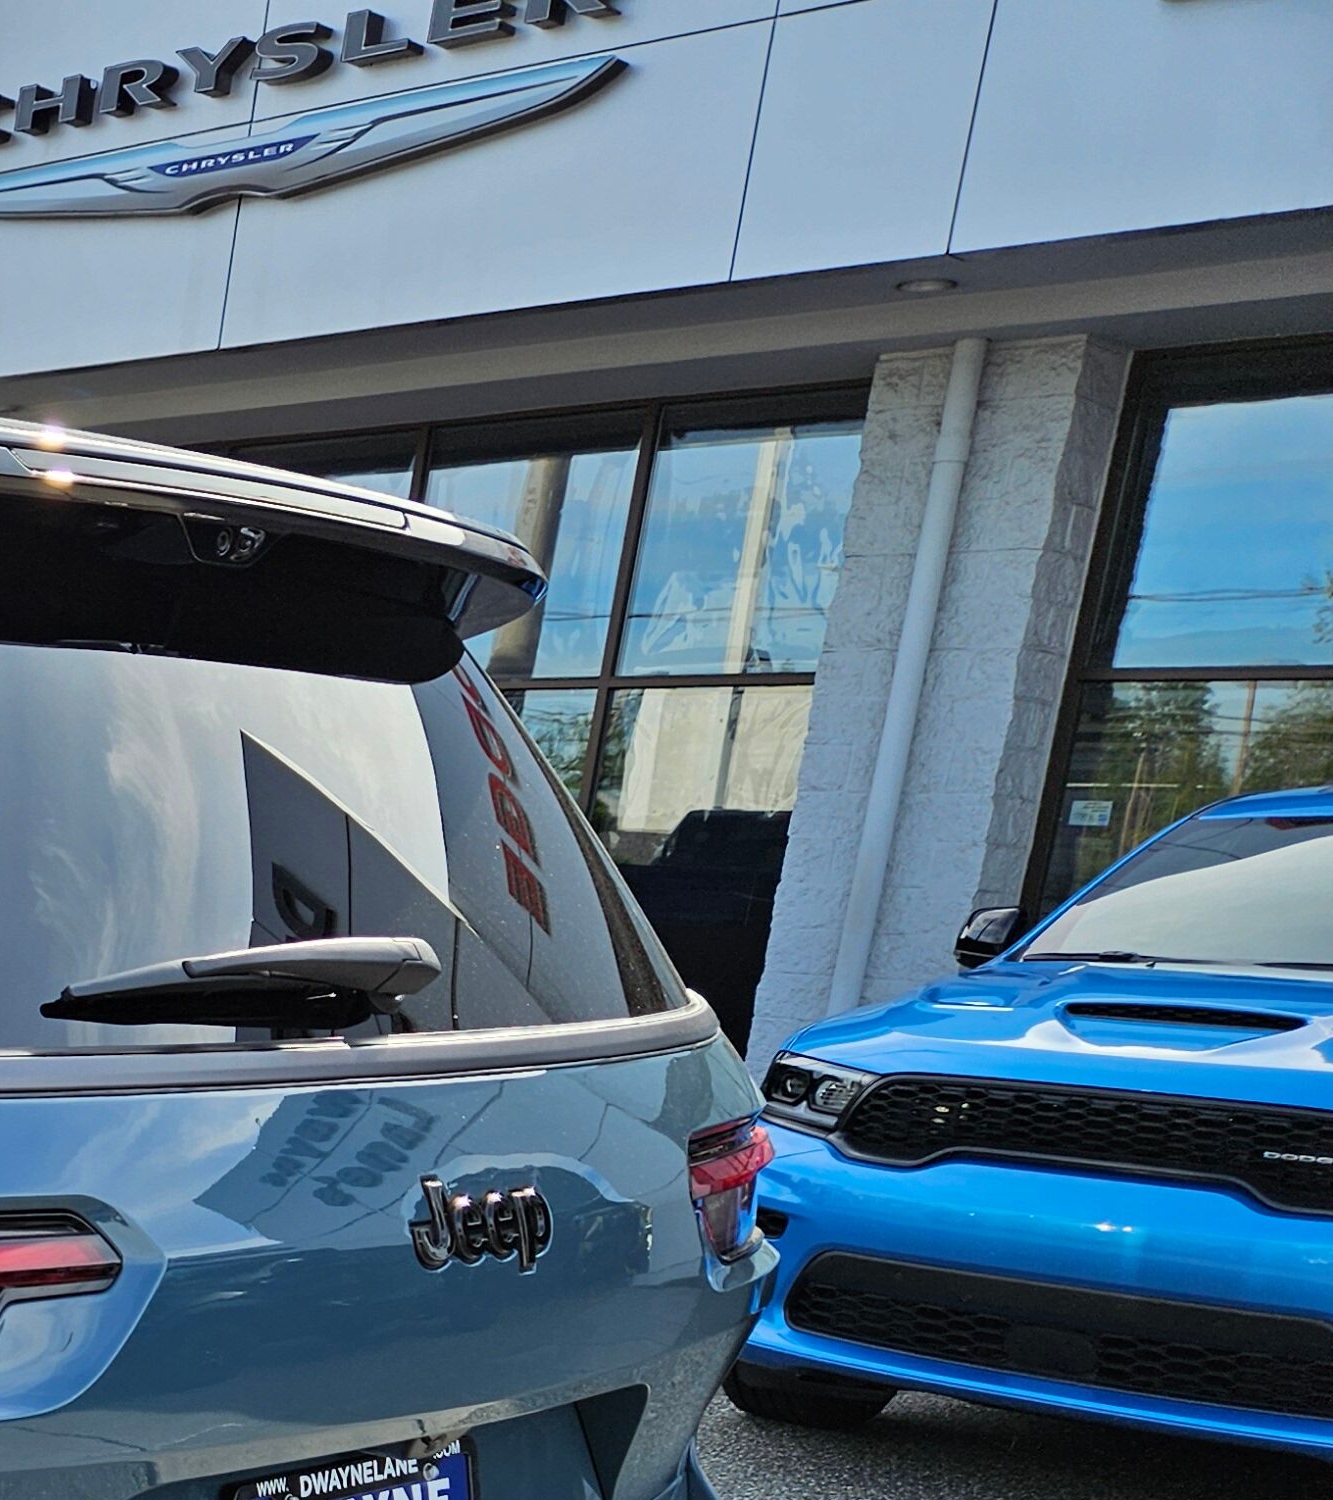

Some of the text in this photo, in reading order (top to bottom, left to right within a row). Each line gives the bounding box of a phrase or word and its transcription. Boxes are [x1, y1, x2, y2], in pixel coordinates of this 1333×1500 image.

[164, 142, 294, 175] CHRYSLER
[1262, 1151, 1333, 1165] DODG
[408, 1174, 553, 1275] Jeep
[299, 1458, 419, 1498] DWAYNELANE
